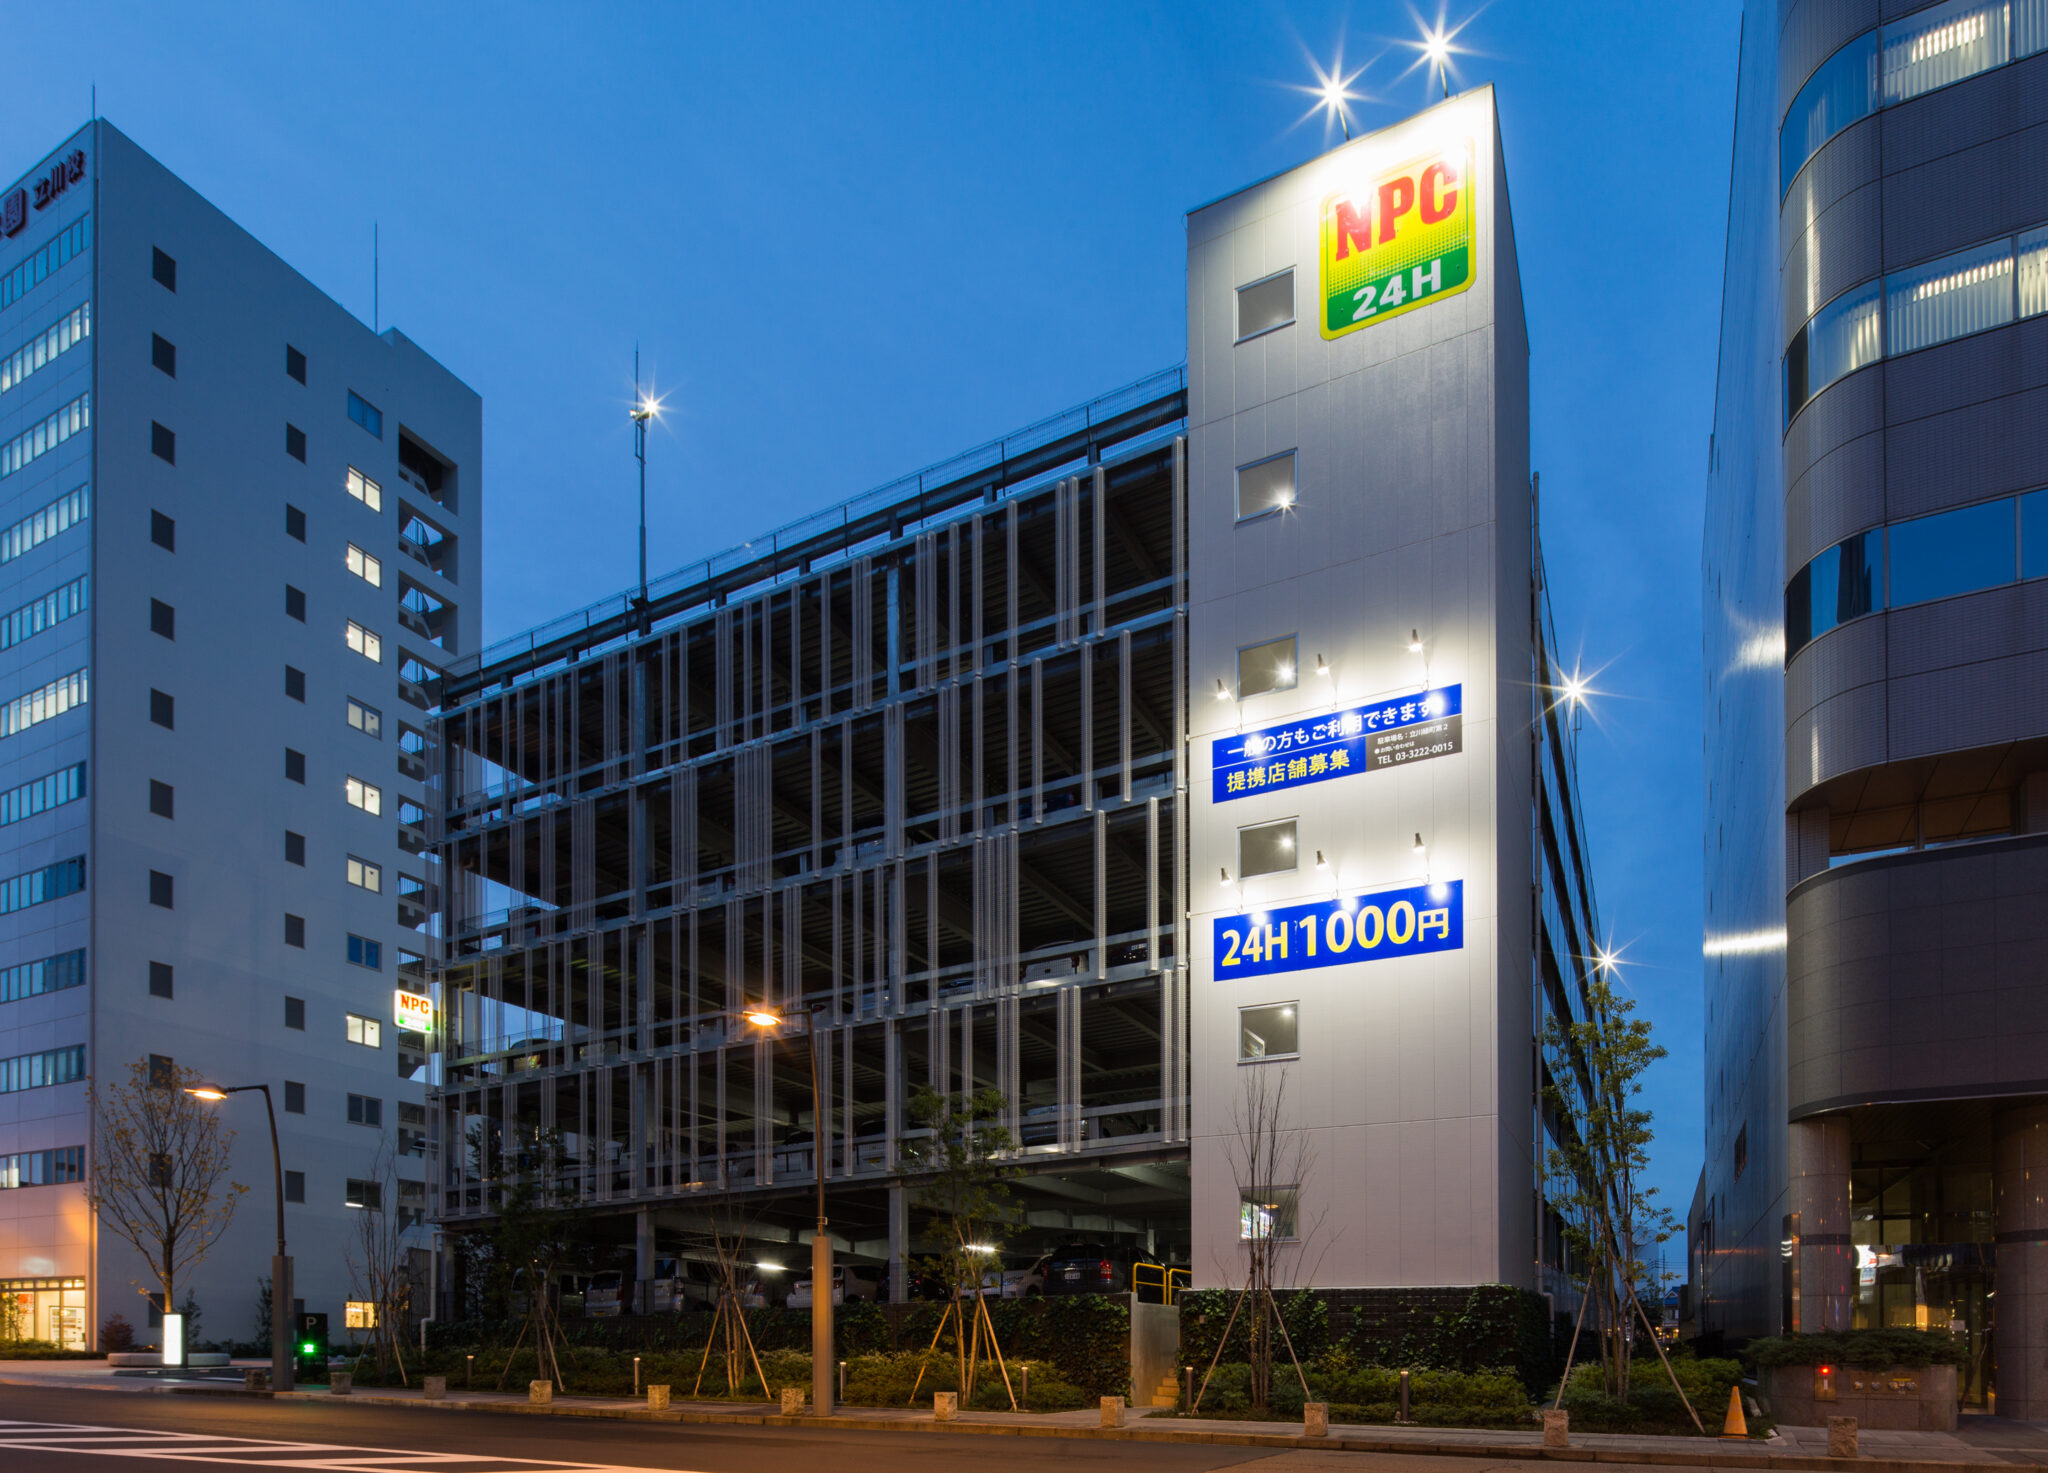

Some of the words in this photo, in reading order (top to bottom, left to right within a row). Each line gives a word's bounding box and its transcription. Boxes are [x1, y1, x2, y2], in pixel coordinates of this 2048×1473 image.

[1336, 161, 1457, 261] NPC
[1352, 258, 1441, 321] 24H
[1227, 749, 1350, 793] 提携店舗募集
[1377, 754, 1393, 765] TEL
[1395, 741, 1454, 762] 03-3222-0015
[1221, 921, 1289, 967] 24H
[1299, 900, 1450, 957] 1000円
[401, 994, 429, 1015] NPC
[306, 1317, 317, 1330] P
